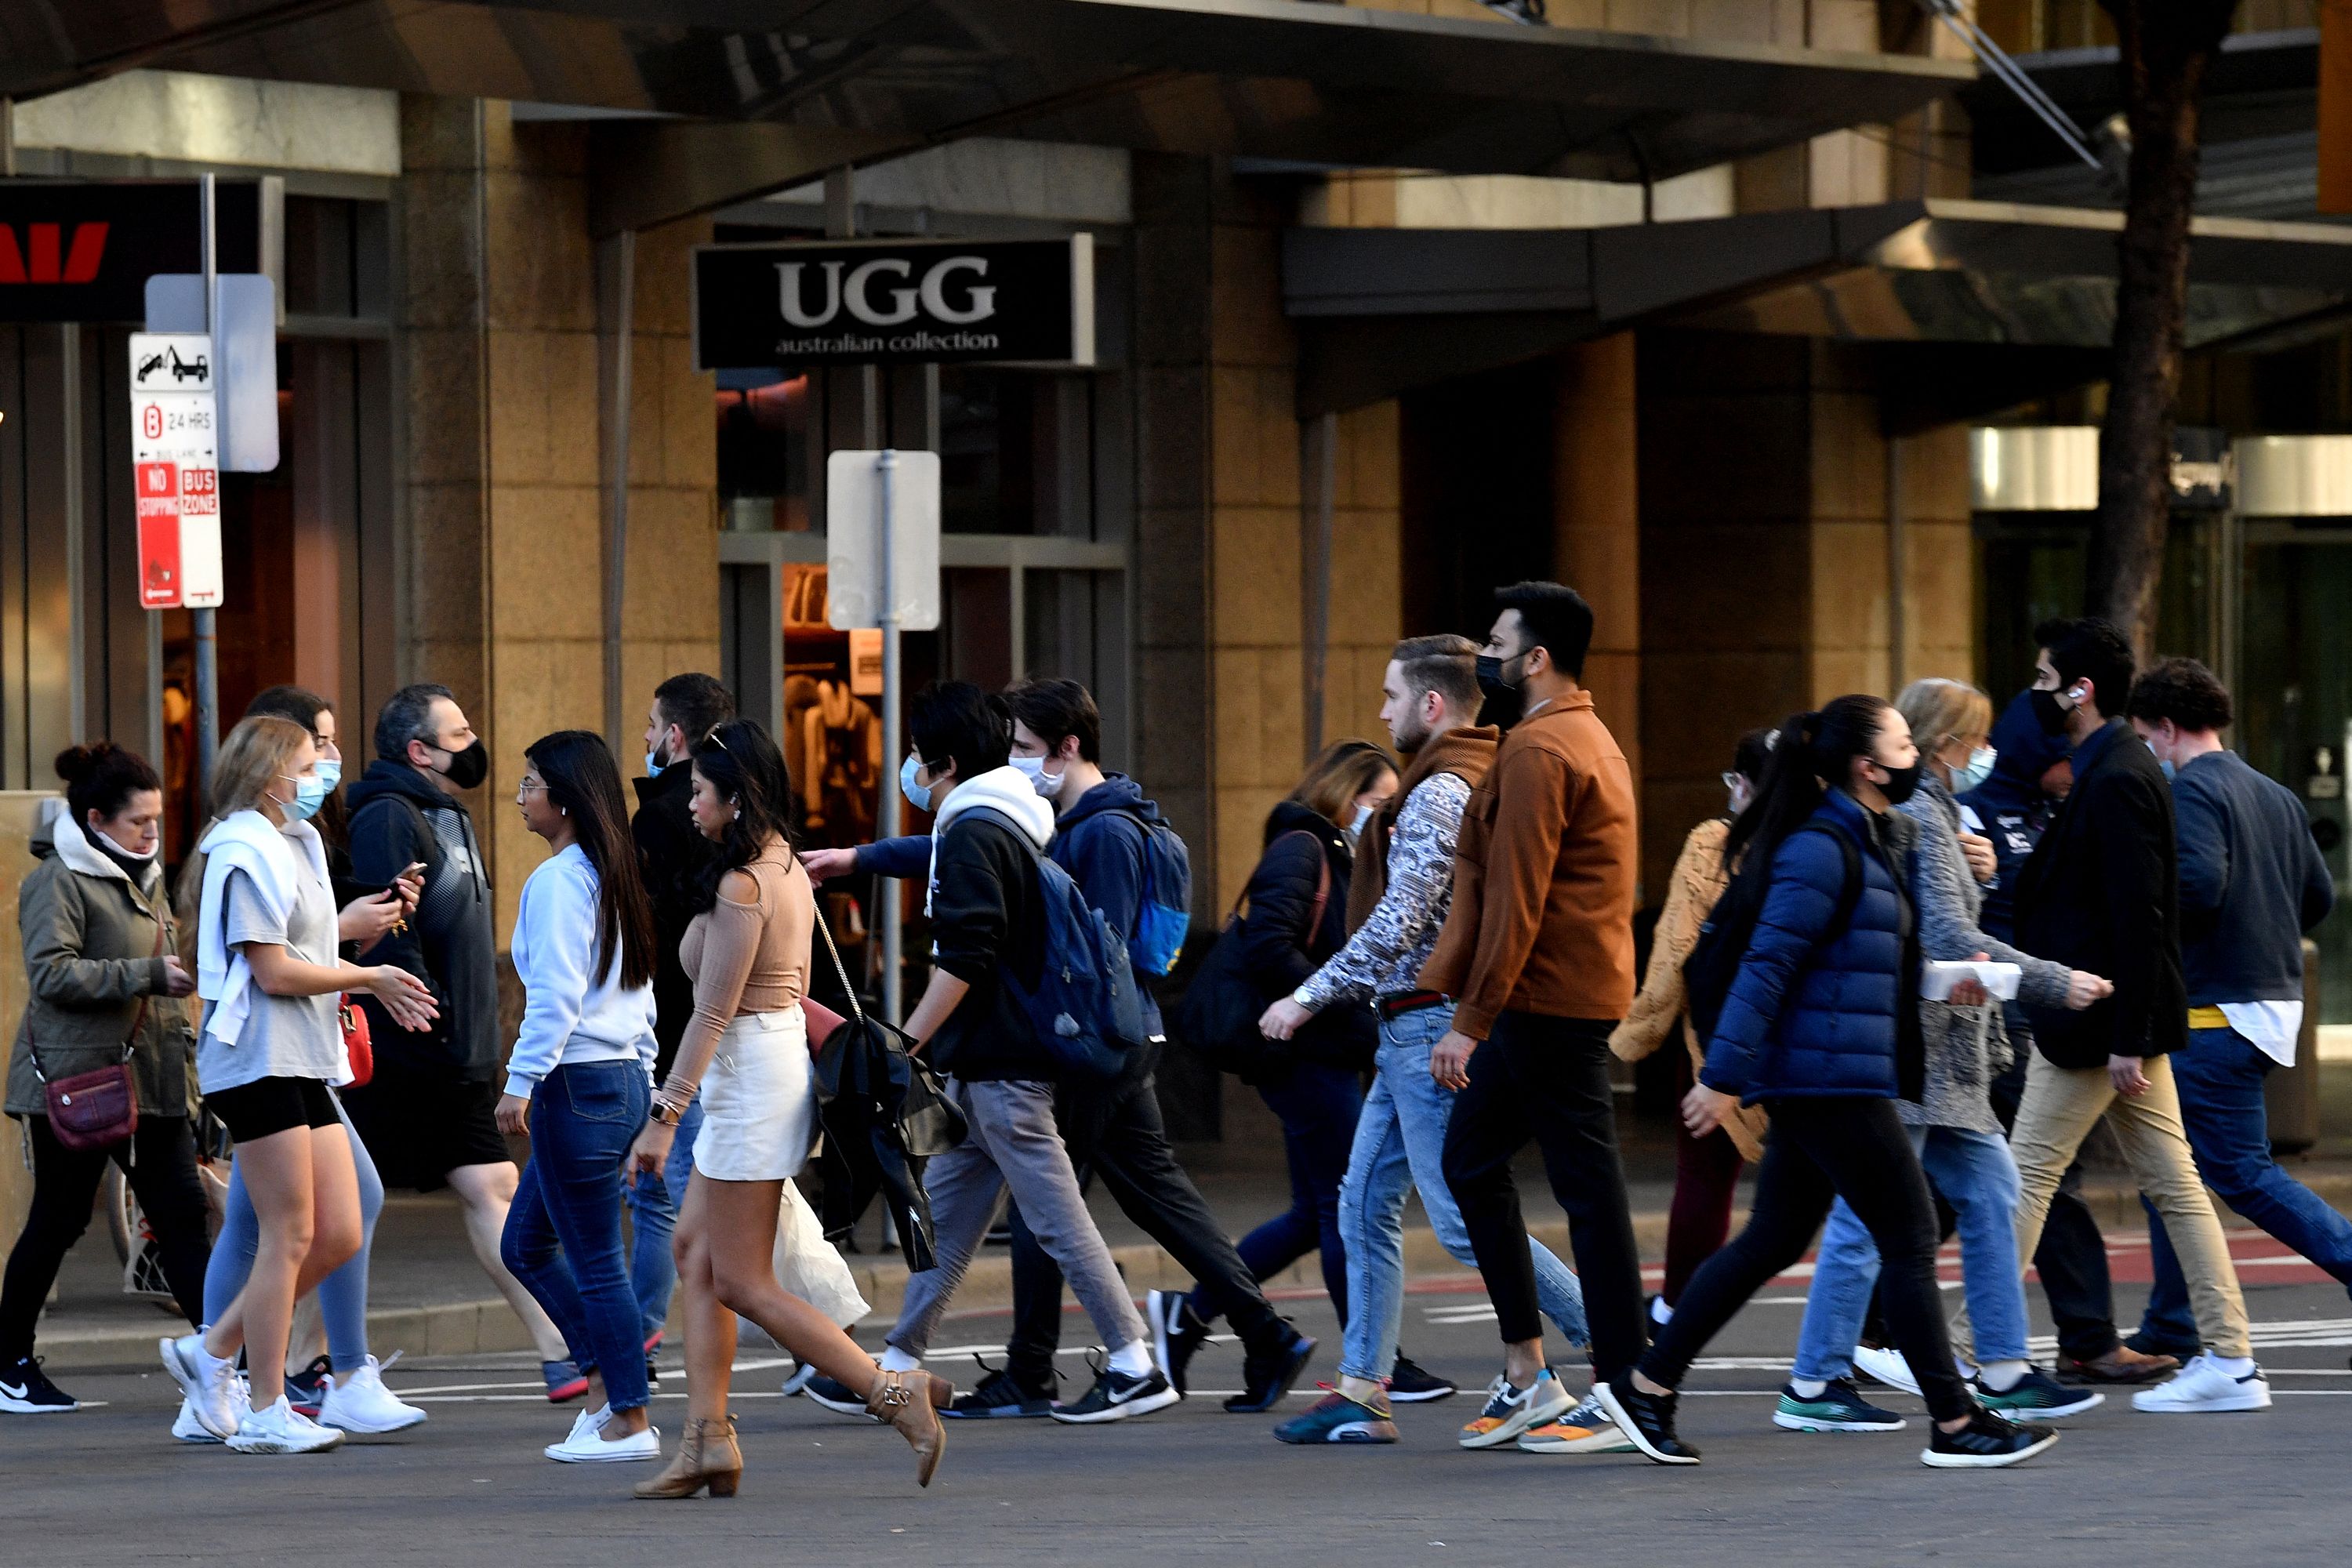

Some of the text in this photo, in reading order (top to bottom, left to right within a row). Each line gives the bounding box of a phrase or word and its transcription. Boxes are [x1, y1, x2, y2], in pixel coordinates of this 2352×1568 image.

[772, 255, 997, 328] UGG
[775, 330, 1000, 355] australian collection
[169, 412, 184, 430] 24
[189, 412, 211, 430] HRS
[147, 468, 167, 492] NO
[184, 471, 214, 492] BUS
[183, 494, 216, 514] ZONE
